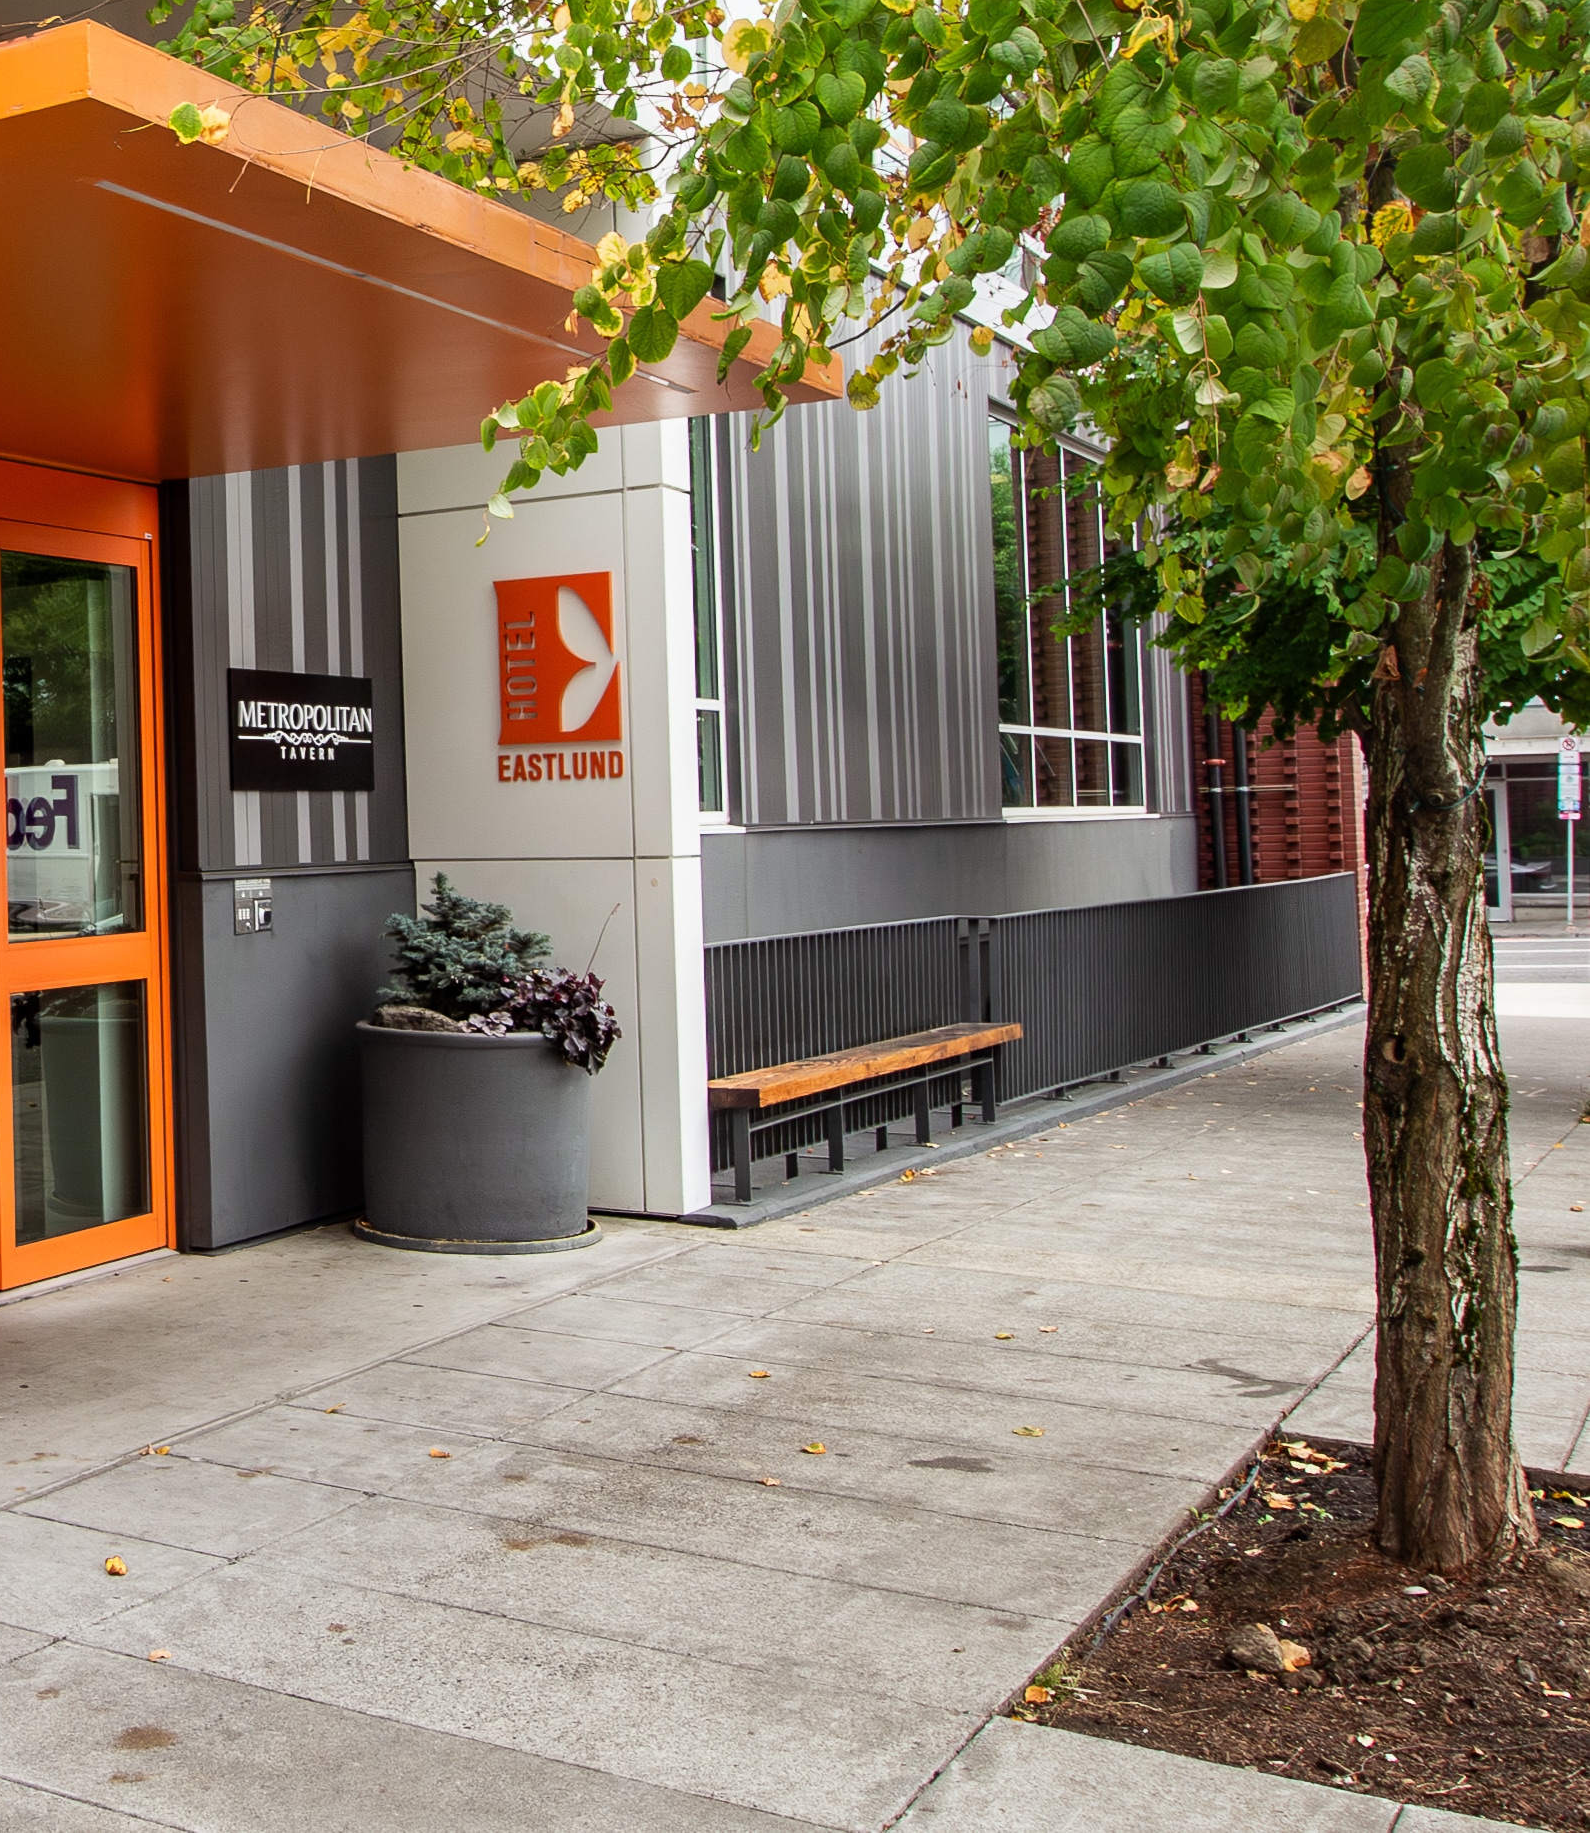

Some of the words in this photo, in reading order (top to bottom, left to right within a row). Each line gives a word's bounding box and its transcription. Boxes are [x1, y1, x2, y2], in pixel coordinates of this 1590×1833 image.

[504, 611, 538, 720] HOTEL
[238, 700, 373, 732] METROPOLITAN
[280, 746, 335, 760] TAVERN
[497, 750, 624, 783] EASTLUND
